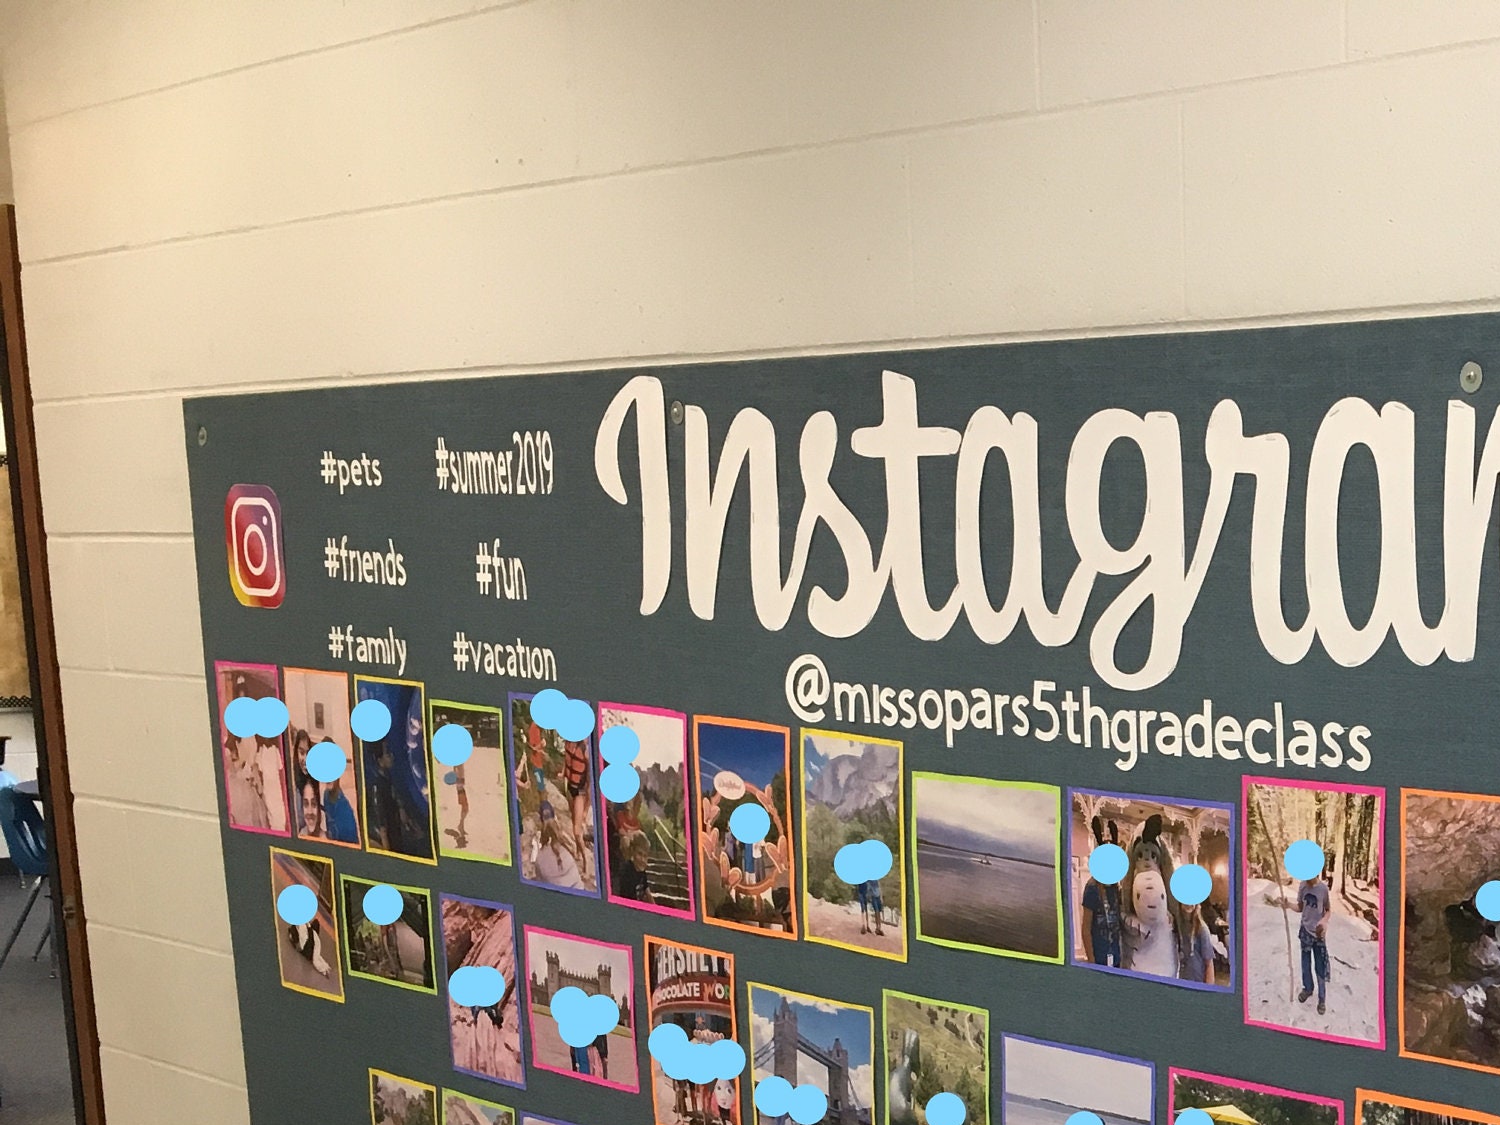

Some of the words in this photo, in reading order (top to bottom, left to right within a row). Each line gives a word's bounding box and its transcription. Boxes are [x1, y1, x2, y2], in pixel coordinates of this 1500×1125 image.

[321, 450, 382, 495] #pets
[436, 431, 554, 495] #summer2019
[324, 535, 406, 587] #friends
[476, 539, 528, 601] #fun
[328, 625, 406, 678] #family
[453, 631, 557, 682] #vacation
[785, 653, 1373, 775] @missopars5thgradeclass
